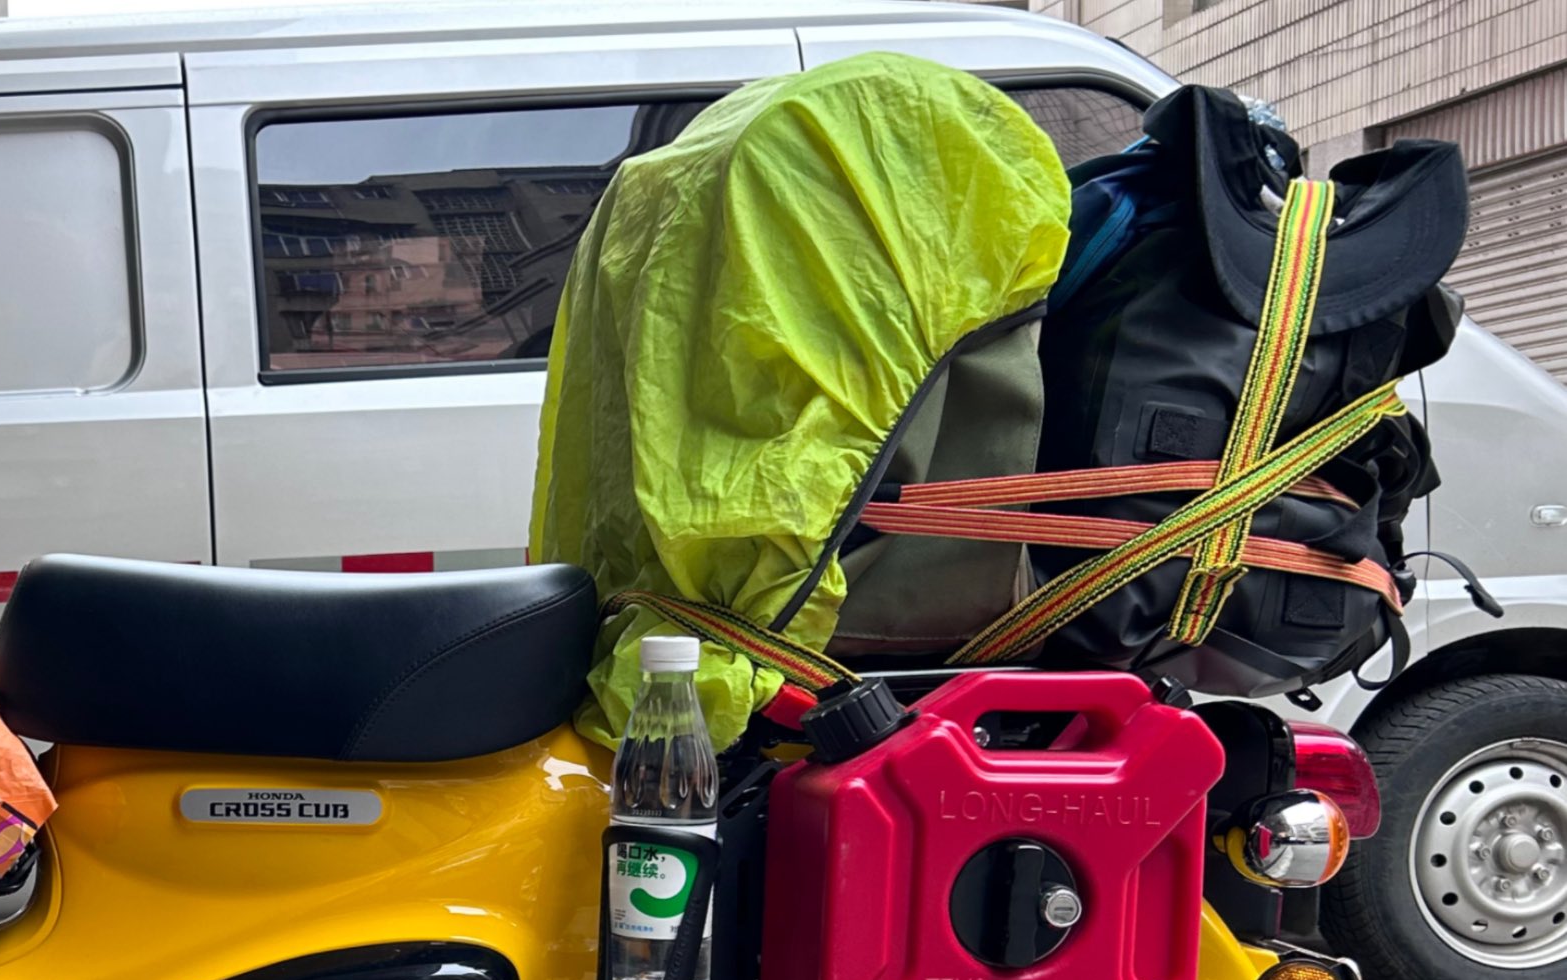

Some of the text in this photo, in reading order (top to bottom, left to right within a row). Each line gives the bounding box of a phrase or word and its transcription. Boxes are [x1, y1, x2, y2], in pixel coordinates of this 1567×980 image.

[248, 792, 305, 801] HONDA
[209, 802, 349, 819] CROSS CUB
[940, 790, 1161, 826] LONG-HAUL
